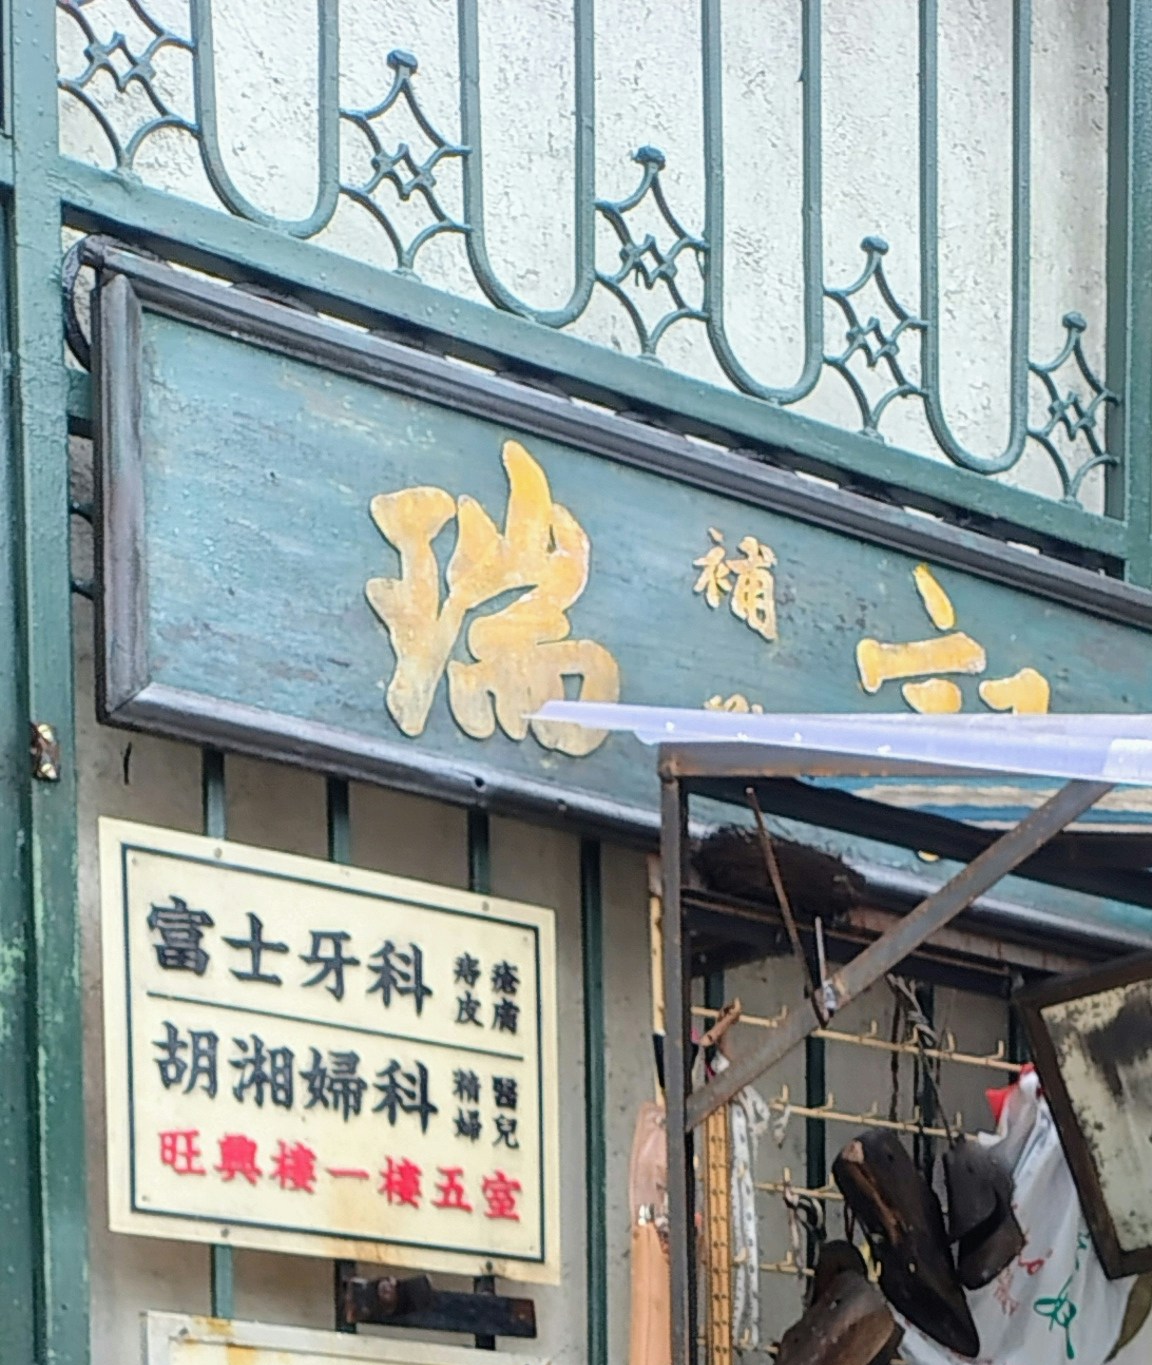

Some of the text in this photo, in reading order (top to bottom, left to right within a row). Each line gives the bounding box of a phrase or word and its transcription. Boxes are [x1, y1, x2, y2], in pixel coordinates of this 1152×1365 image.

[146, 894, 434, 1018] 富士牙科
[151, 1020, 439, 1135] 胡湘婦科
